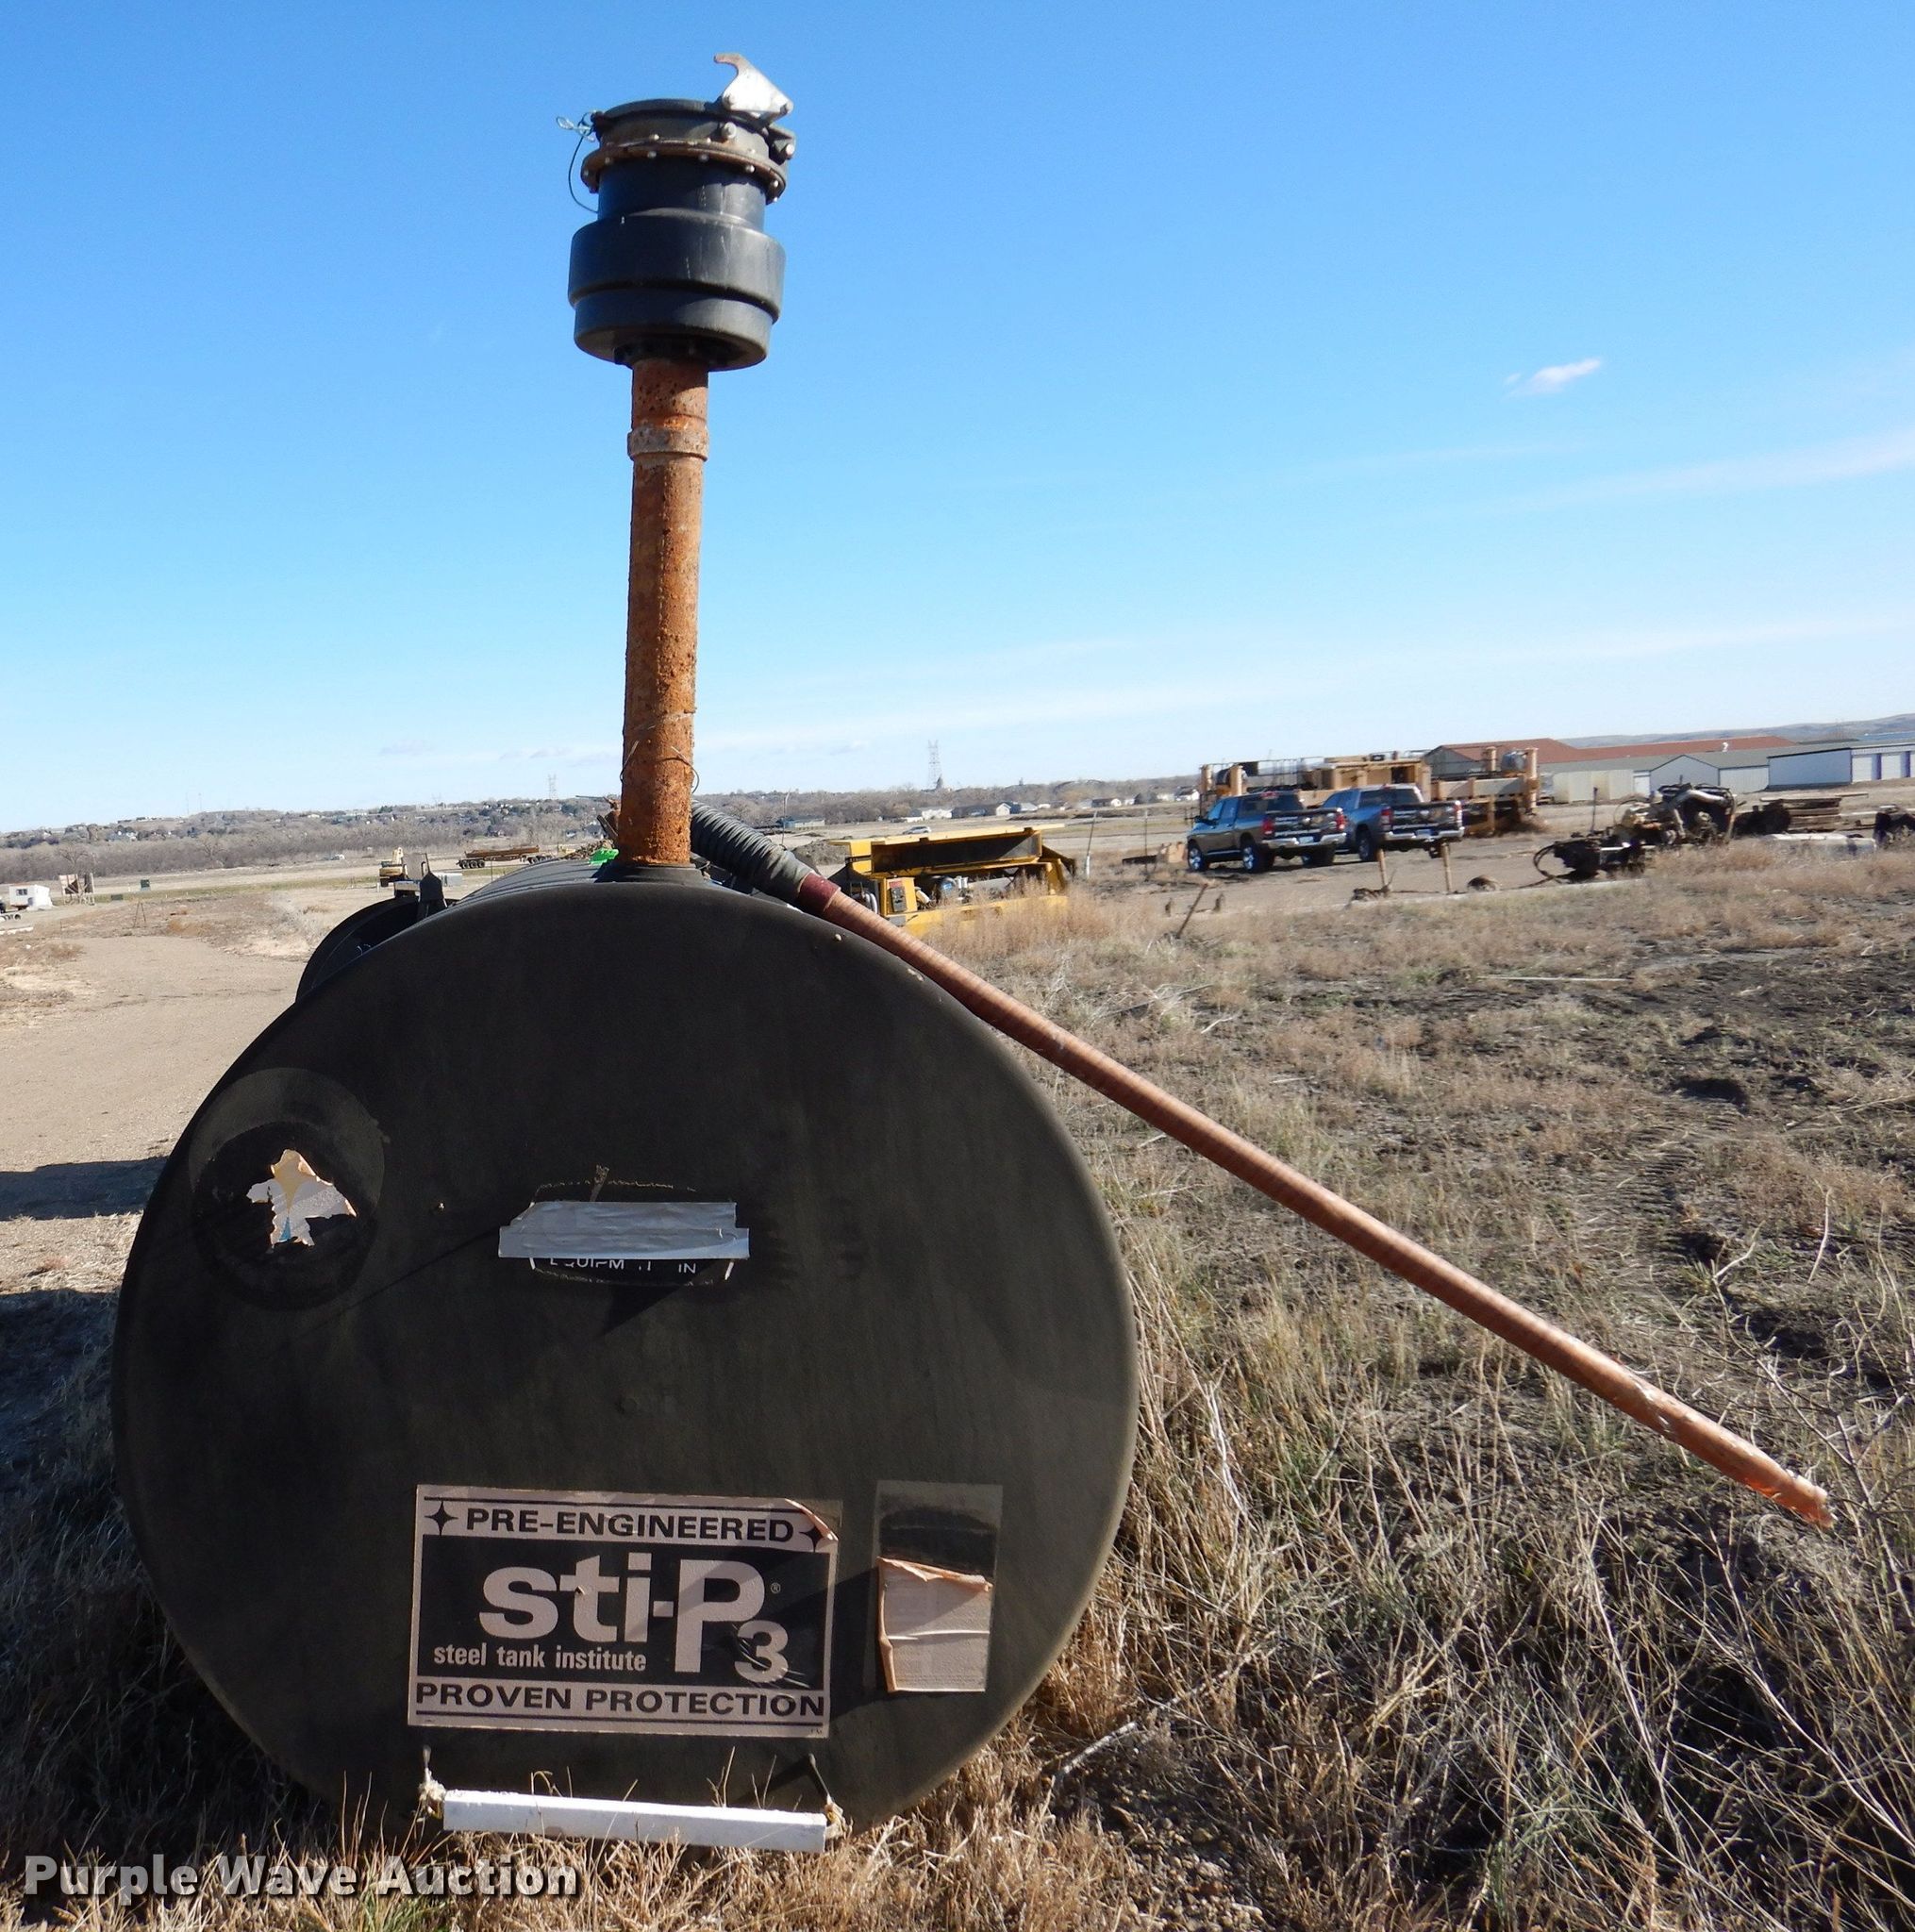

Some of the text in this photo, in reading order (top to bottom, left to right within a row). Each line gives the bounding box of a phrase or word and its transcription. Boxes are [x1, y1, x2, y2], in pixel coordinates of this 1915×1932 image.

[466, 1507, 794, 1542] PRE-ENGINEERED
[434, 1642, 647, 1673] steel tank institute
[415, 1682, 824, 1717] PROVEN PROTECTION
